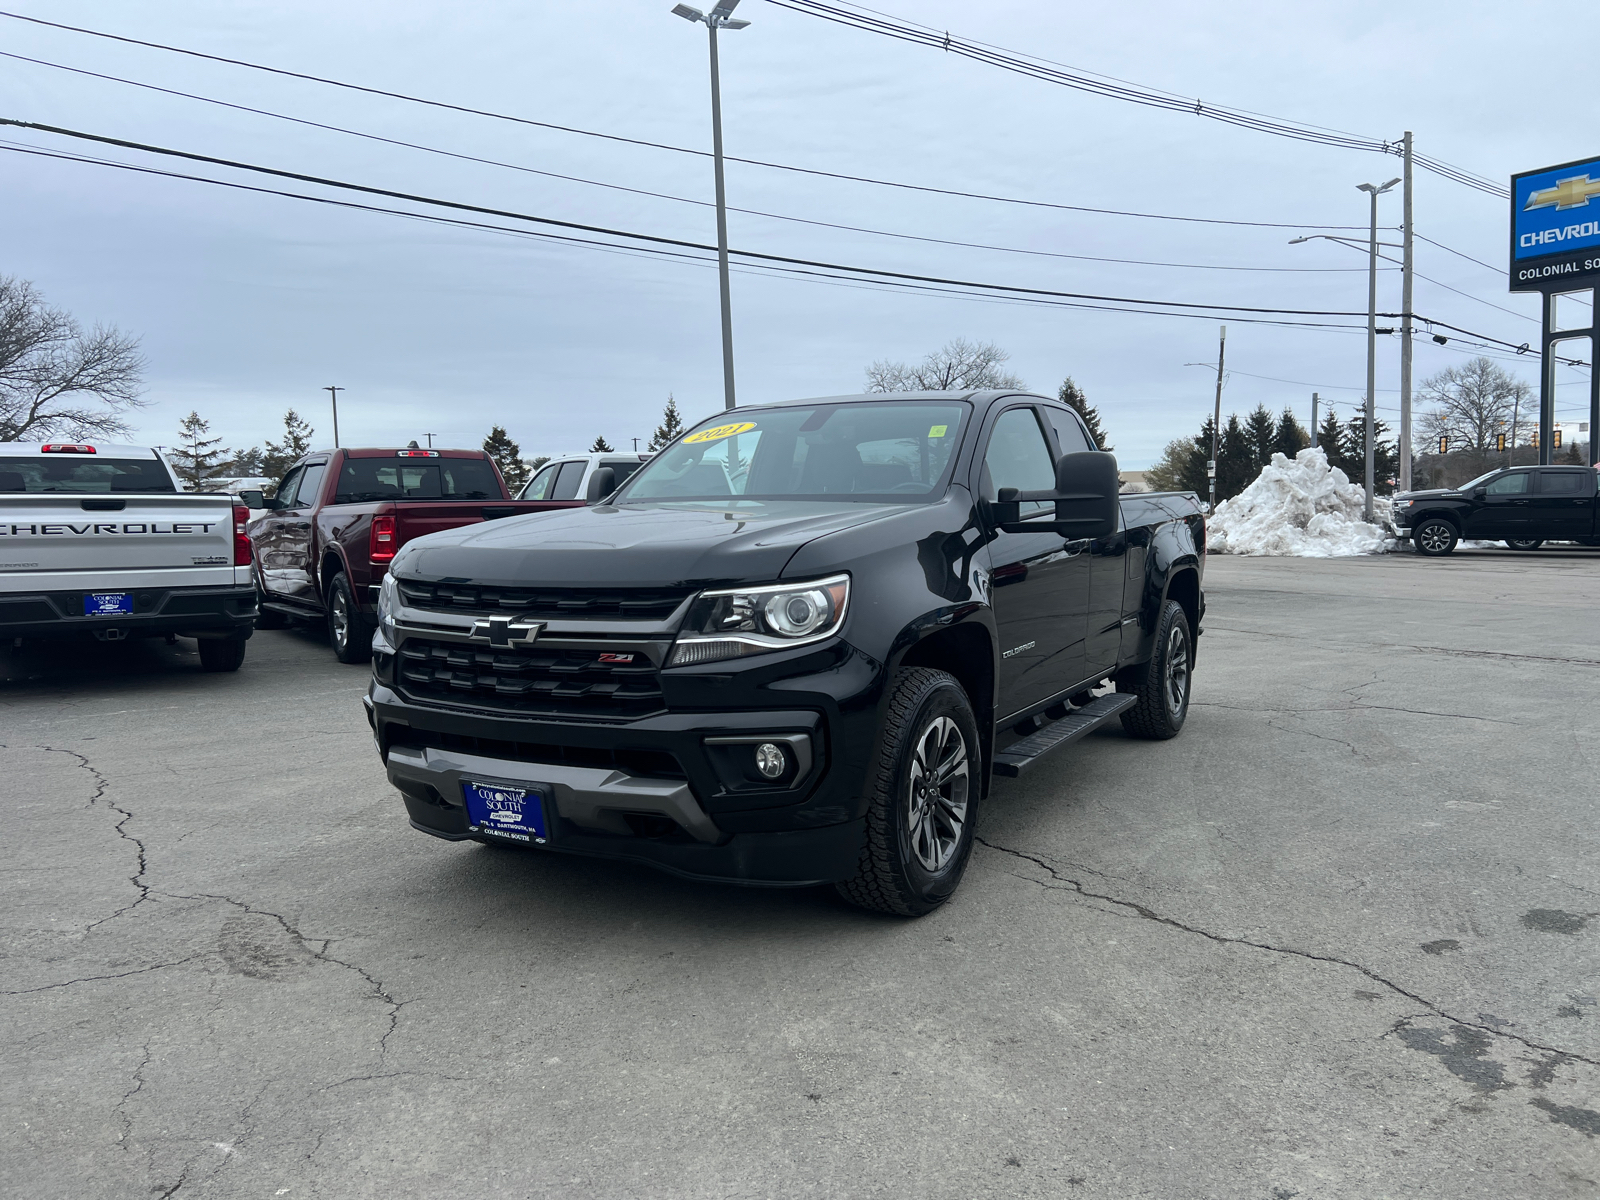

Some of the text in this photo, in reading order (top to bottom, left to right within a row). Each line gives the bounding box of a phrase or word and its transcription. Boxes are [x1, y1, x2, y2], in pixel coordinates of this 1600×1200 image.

[1518, 262, 1580, 280] COLONIAL
[691, 424, 746, 442] 2021
[1002, 641, 1035, 658] COLORADO
[479, 789, 527, 804] COLONIAL
[486, 800, 522, 812] SOUTH
[484, 829, 510, 837] COLONIAL
